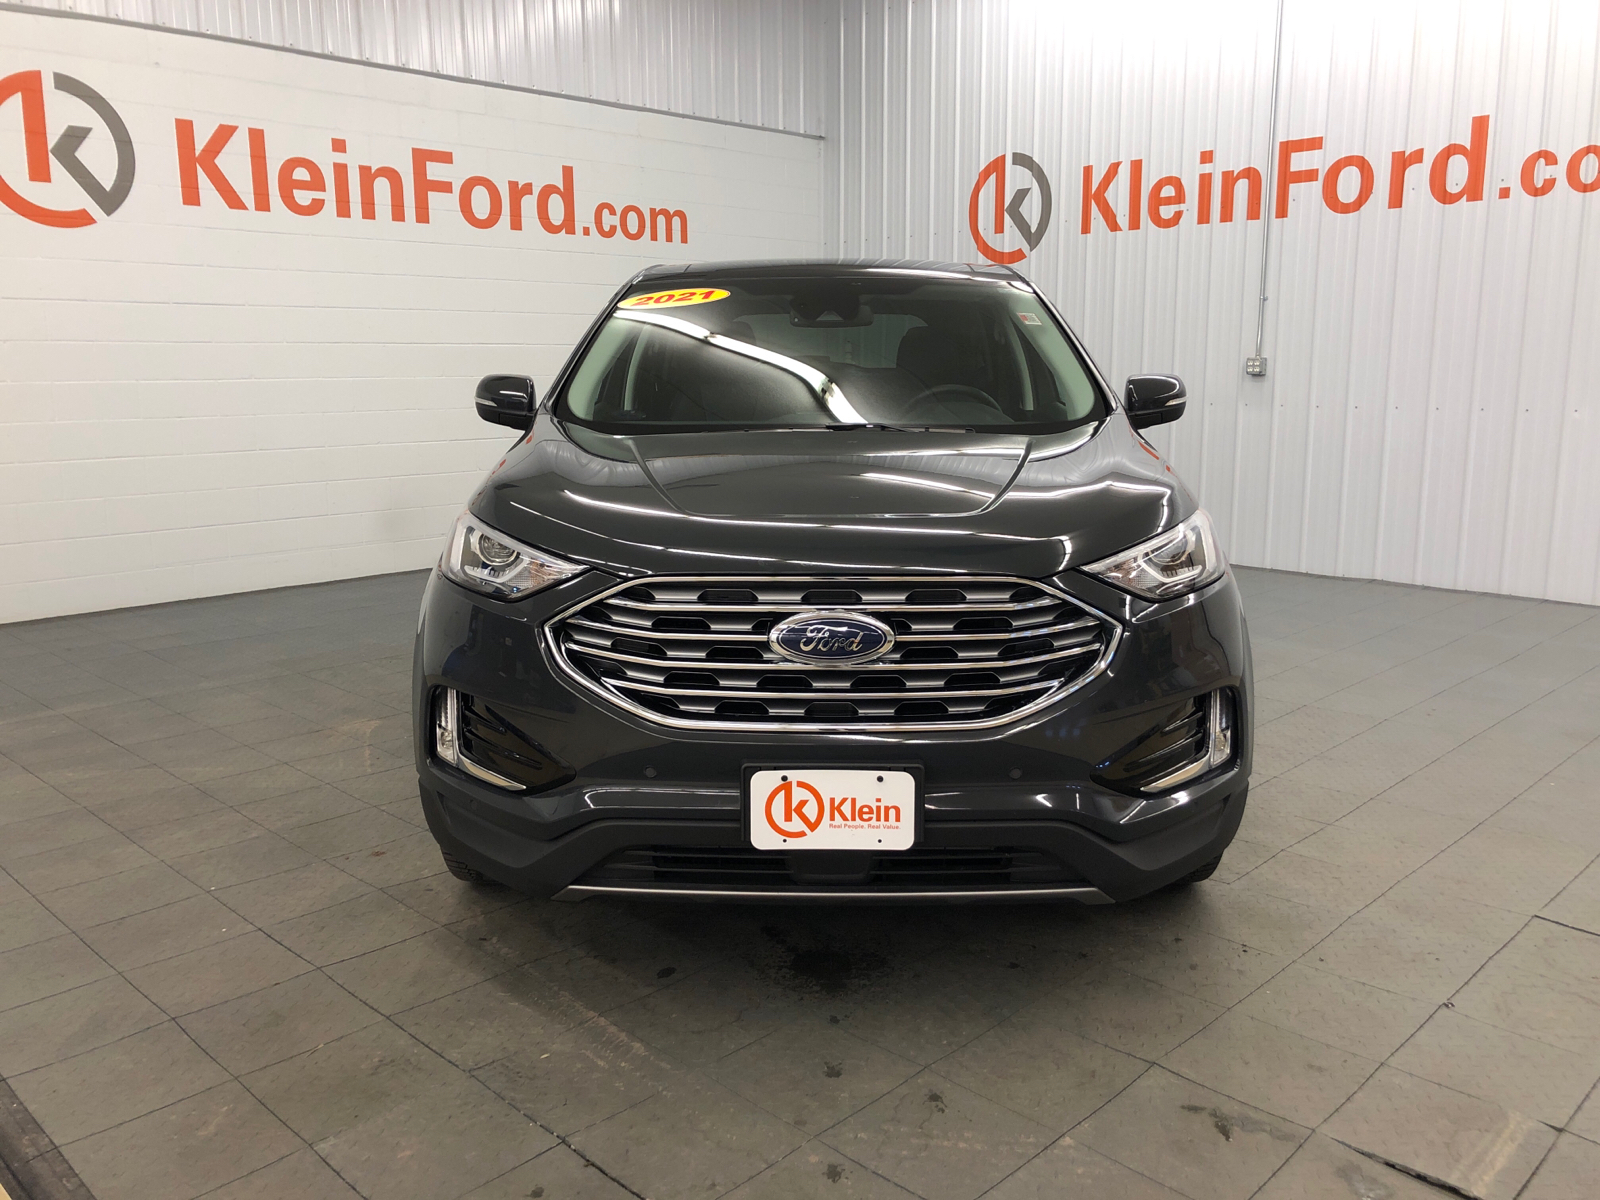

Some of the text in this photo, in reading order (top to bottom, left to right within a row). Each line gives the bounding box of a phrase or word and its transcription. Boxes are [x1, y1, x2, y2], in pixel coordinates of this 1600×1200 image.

[174, 117, 689, 245] KleinFord.com
[629, 290, 717, 307] 2021
[800, 624, 864, 651] Ford
[829, 797, 901, 822] Klein
